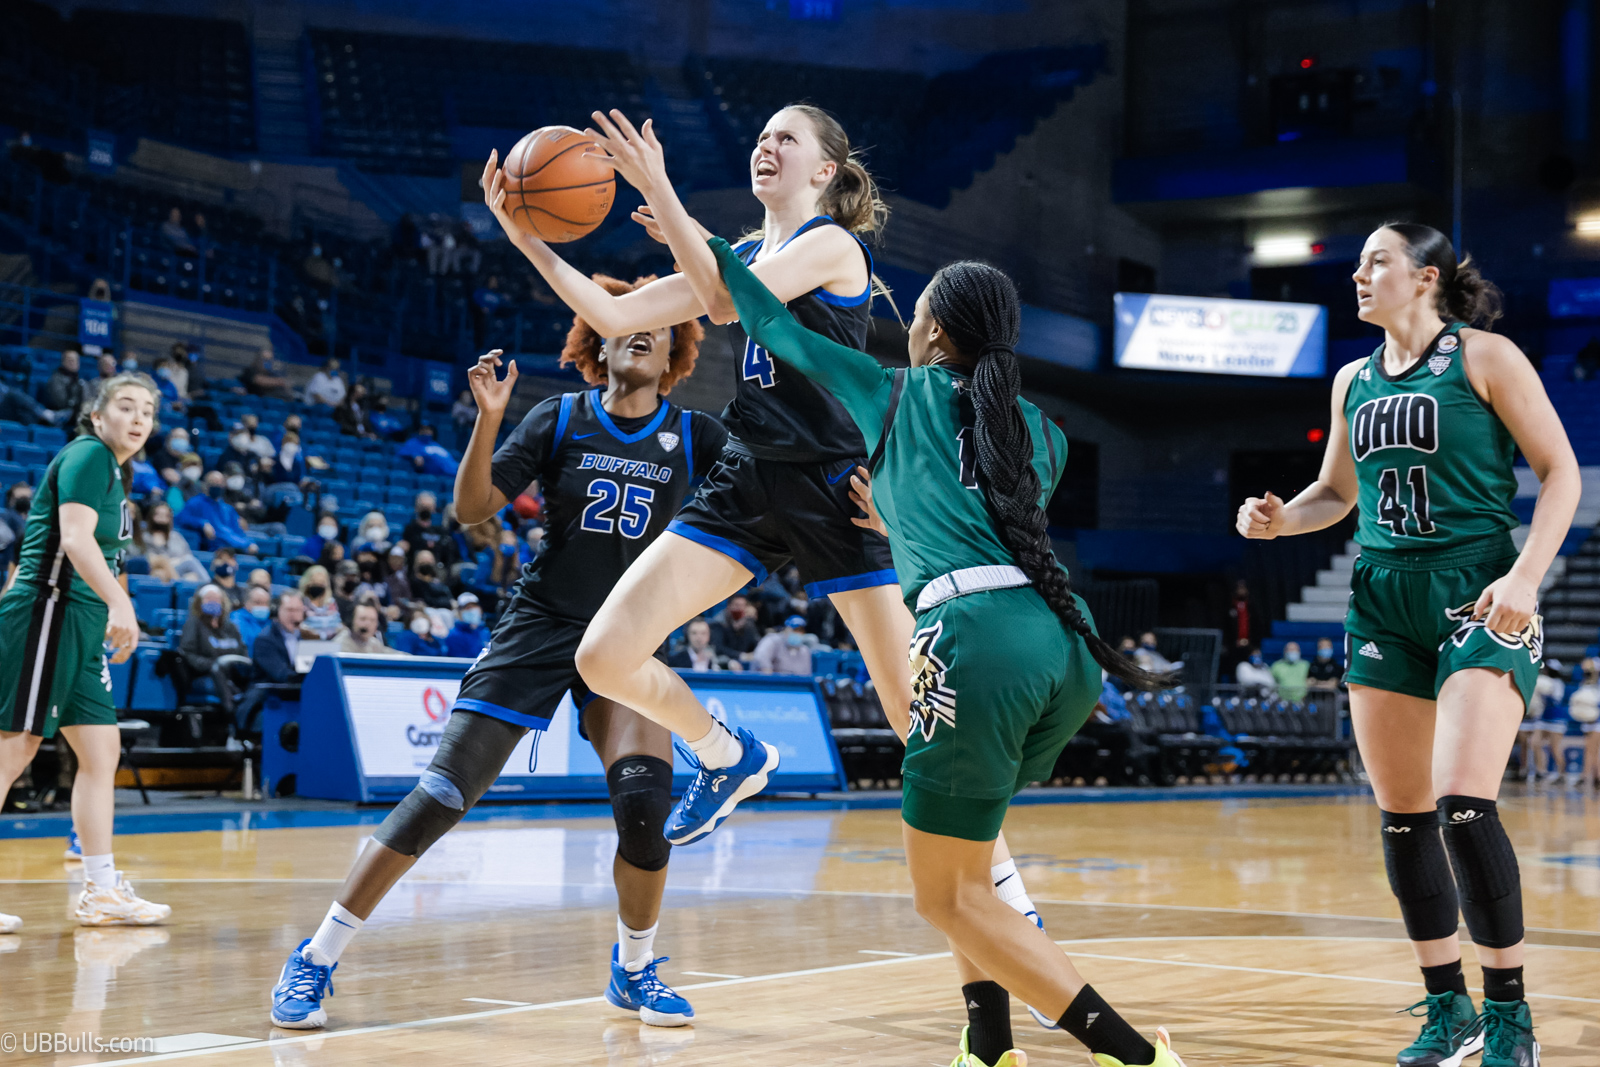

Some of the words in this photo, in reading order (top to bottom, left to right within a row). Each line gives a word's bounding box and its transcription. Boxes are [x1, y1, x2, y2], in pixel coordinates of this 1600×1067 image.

[743, 335, 775, 388] 4
[1352, 393, 1438, 462] OHIO
[576, 453, 672, 484] BUFFALO
[580, 478, 655, 540] 25
[1377, 465, 1436, 537] 41
